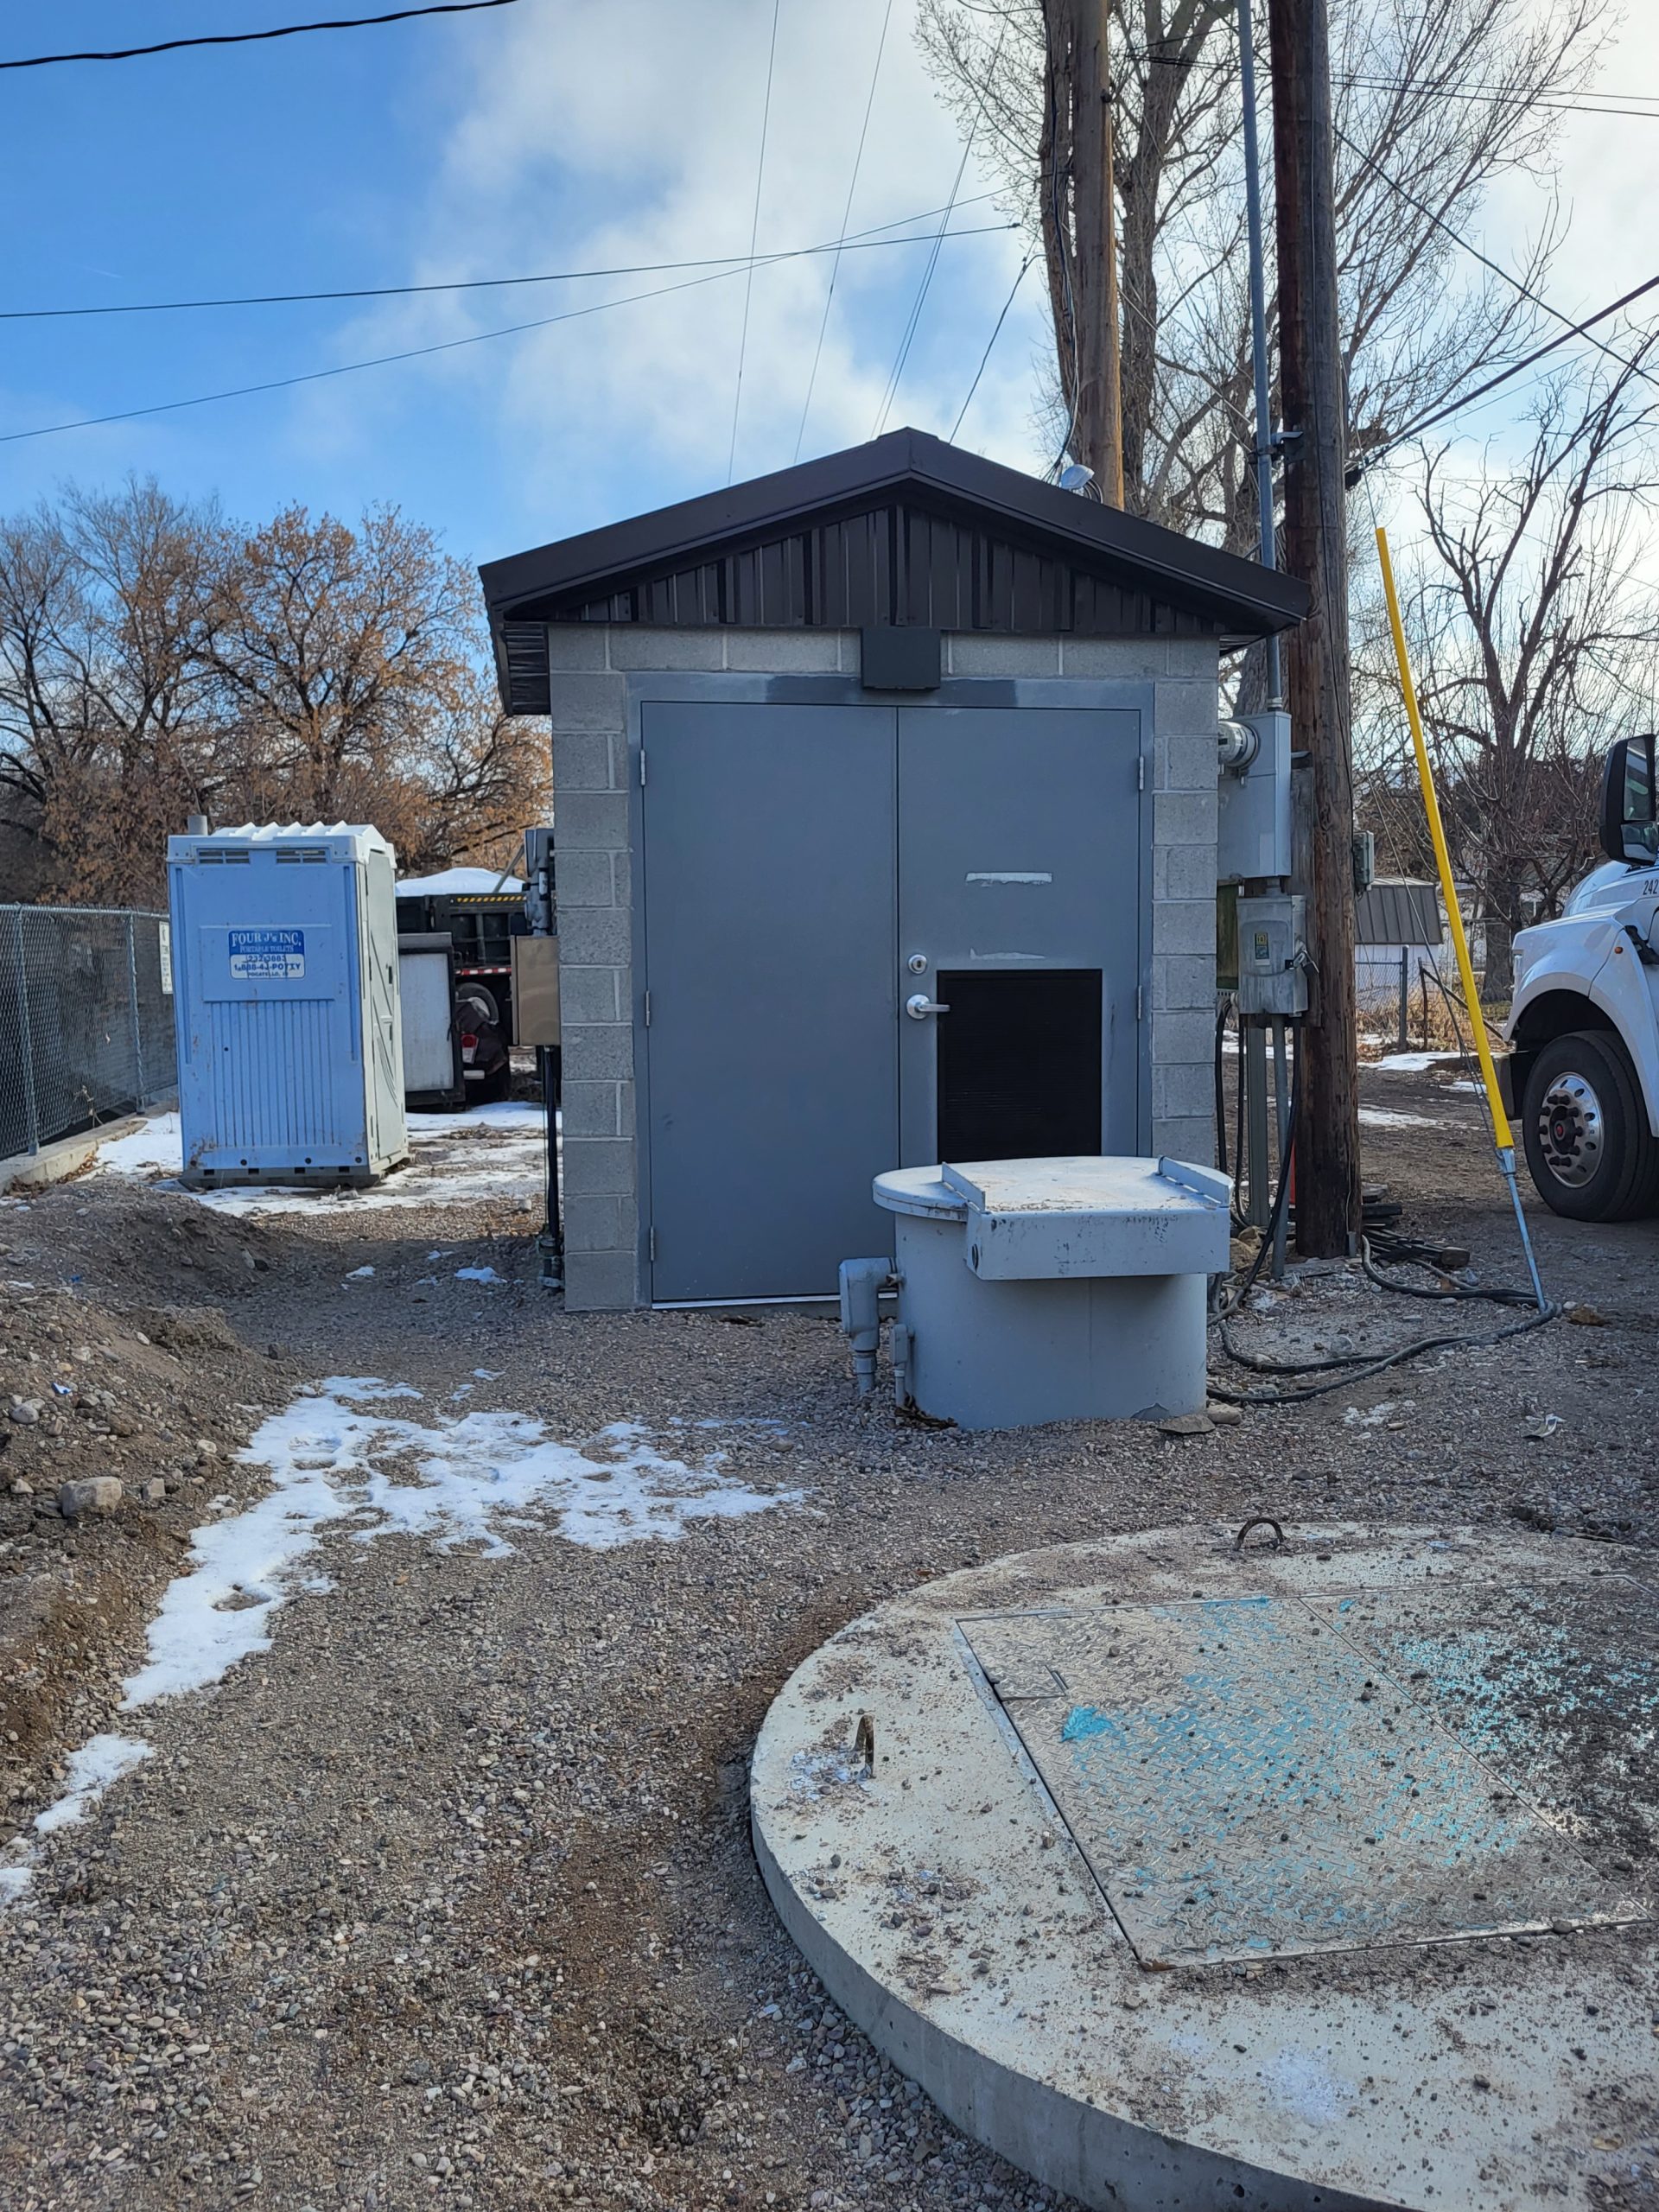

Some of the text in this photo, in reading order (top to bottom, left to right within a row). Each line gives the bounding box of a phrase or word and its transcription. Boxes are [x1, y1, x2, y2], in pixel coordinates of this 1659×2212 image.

[1643, 879, 1659, 895] 242
[232, 932, 262, 947] FOUR
[264, 932, 276, 943] J's
